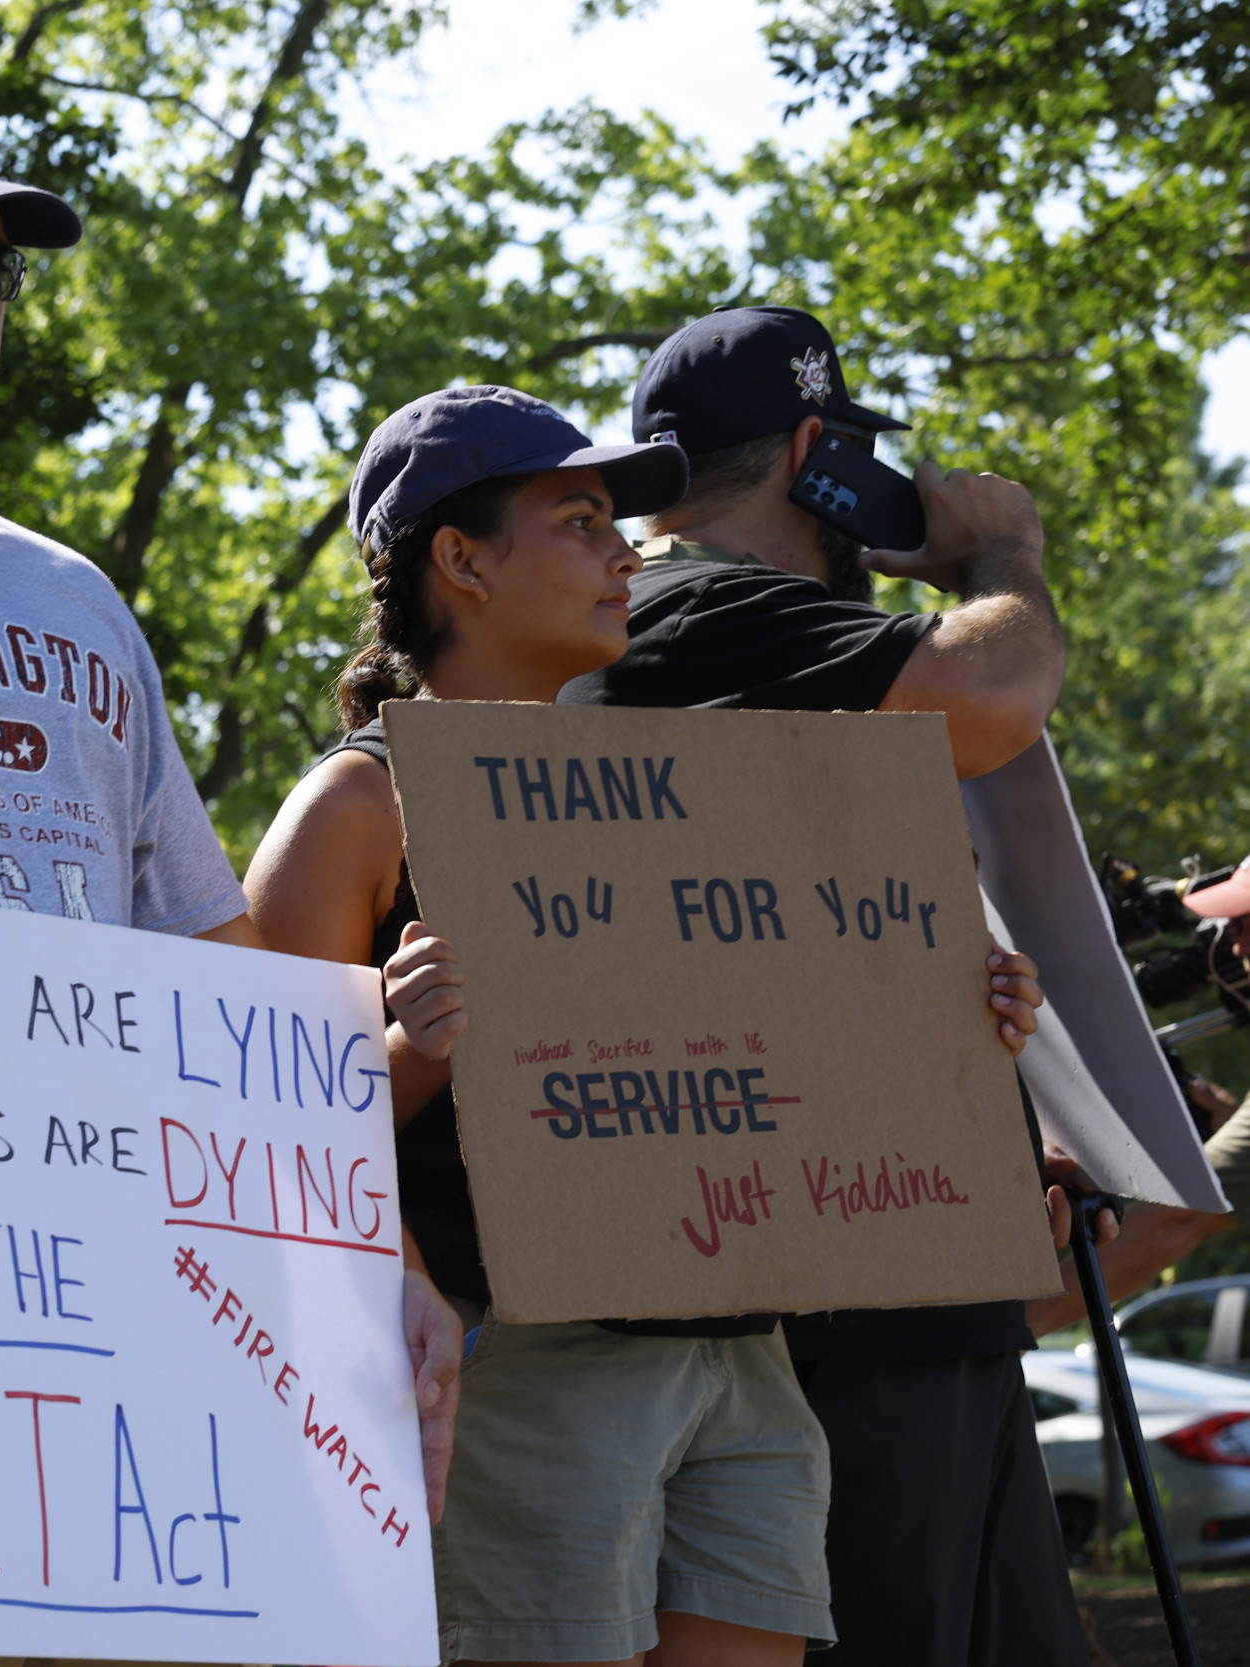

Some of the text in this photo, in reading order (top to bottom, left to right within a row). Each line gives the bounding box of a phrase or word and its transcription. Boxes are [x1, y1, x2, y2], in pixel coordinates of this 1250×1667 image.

[14, 793, 43, 812] OF
[474, 757, 687, 821] THANK
[19, 826, 105, 856] CAPITAL
[671, 879, 786, 943] FOR
[27, 975, 141, 1053] ARE
[173, 990, 389, 1112] LYING
[685, 1035, 727, 1056] health
[744, 1032, 767, 1055] life
[542, 1067, 778, 1139] SERVICE
[44, 1115, 147, 1175] ARE
[160, 1117, 388, 1240] DYING
[114, 1403, 240, 1588] Act
